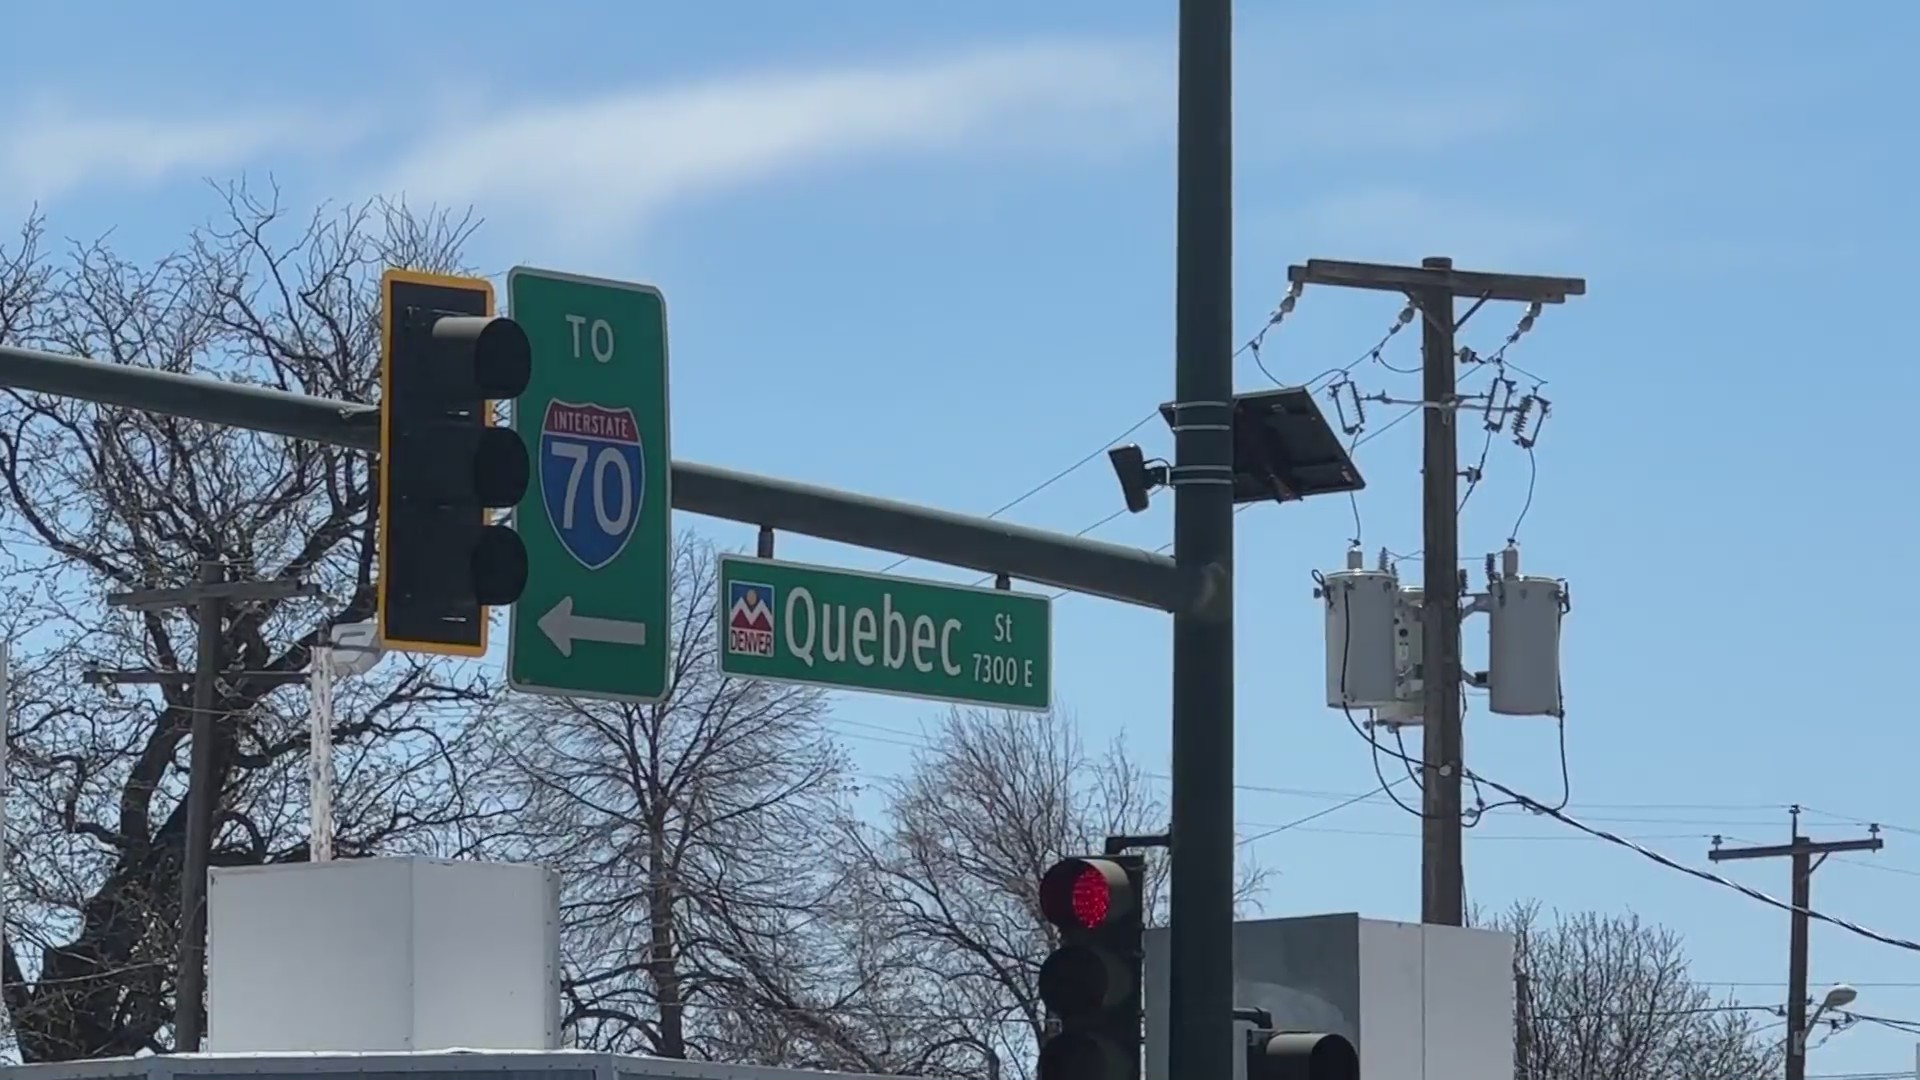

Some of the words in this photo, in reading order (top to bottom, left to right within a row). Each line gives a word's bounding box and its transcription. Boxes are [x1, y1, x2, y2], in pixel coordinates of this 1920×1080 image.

[565, 314, 615, 363] TO
[553, 409, 630, 438] INTERSTATE
[550, 441, 632, 536] 70
[730, 630, 773, 655] DENVER
[784, 586, 962, 677] Quebec
[994, 612, 1013, 643] St
[972, 653, 1018, 686] 7300
[1024, 659, 1033, 687] E
